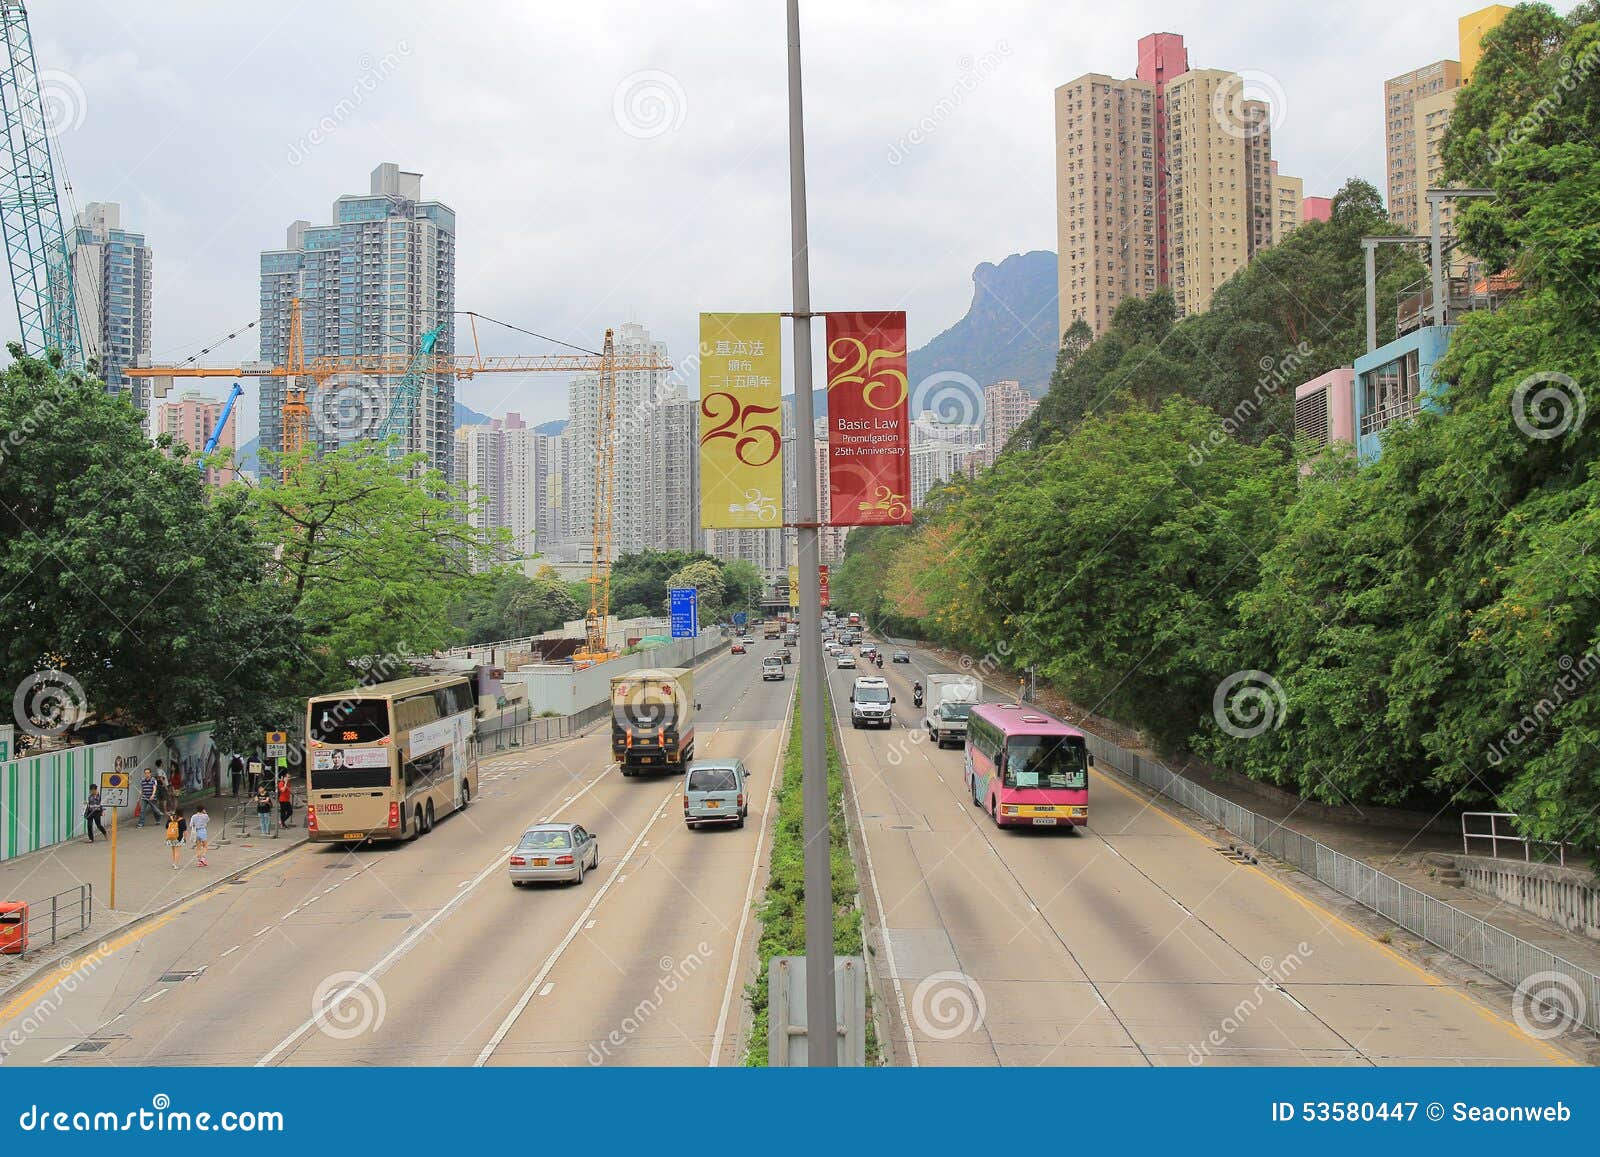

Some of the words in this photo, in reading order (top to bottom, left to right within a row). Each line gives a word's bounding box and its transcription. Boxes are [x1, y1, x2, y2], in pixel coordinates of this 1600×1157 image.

[714, 340, 765, 357] 基本法
[827, 337, 908, 410] 25
[707, 375, 772, 388] 二十五周年
[700, 392, 782, 467] 25
[838, 418, 871, 431] Basic
[874, 418, 899, 430] Law
[842, 433, 899, 444] Promulgation
[834, 447, 854, 456] 25th
[856, 446, 906, 457] Anniversary
[123, 756, 138, 769] MTR
[324, 803, 344, 812] KMB
